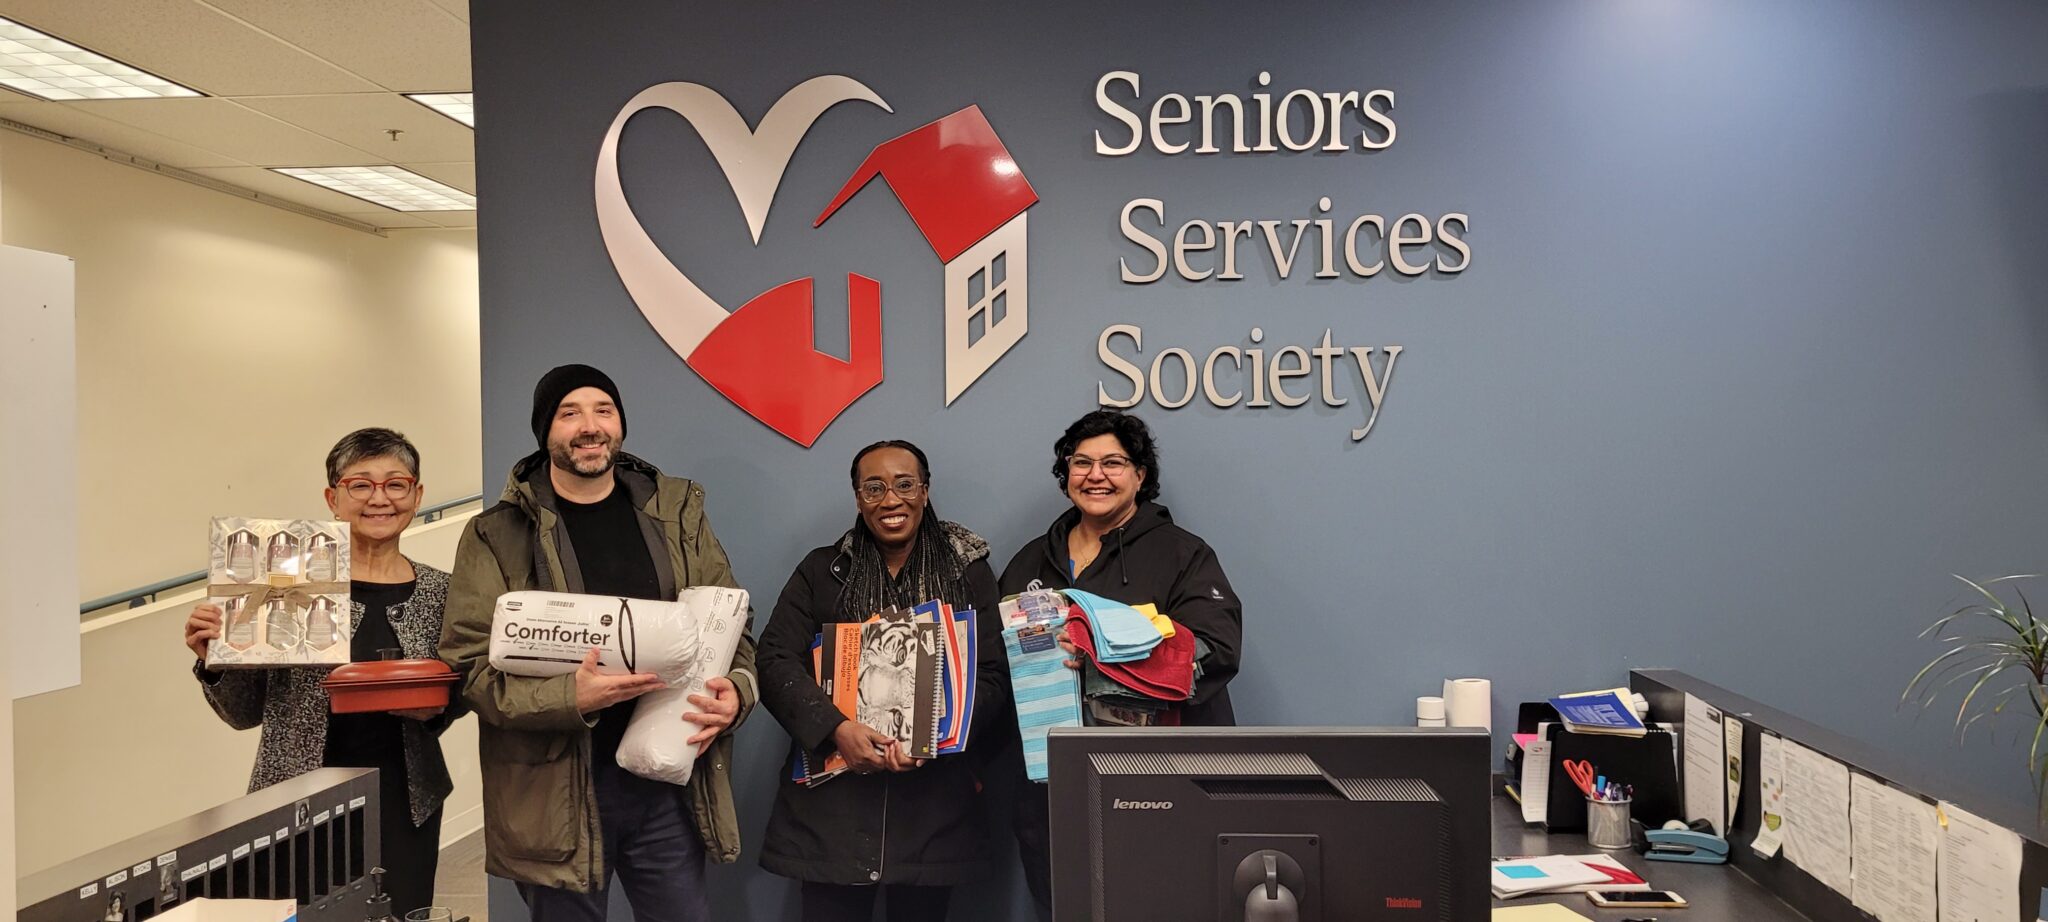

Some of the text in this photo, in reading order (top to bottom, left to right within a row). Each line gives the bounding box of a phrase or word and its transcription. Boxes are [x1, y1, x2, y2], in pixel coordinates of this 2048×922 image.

[1095, 70, 1397, 156] Seniors
[1120, 196, 1472, 284] Services
[1098, 324, 1403, 441] Society
[504, 622, 611, 646] Comforter
[1113, 798, 1174, 810] lenovo
[81, 885, 97, 897] KELLY
